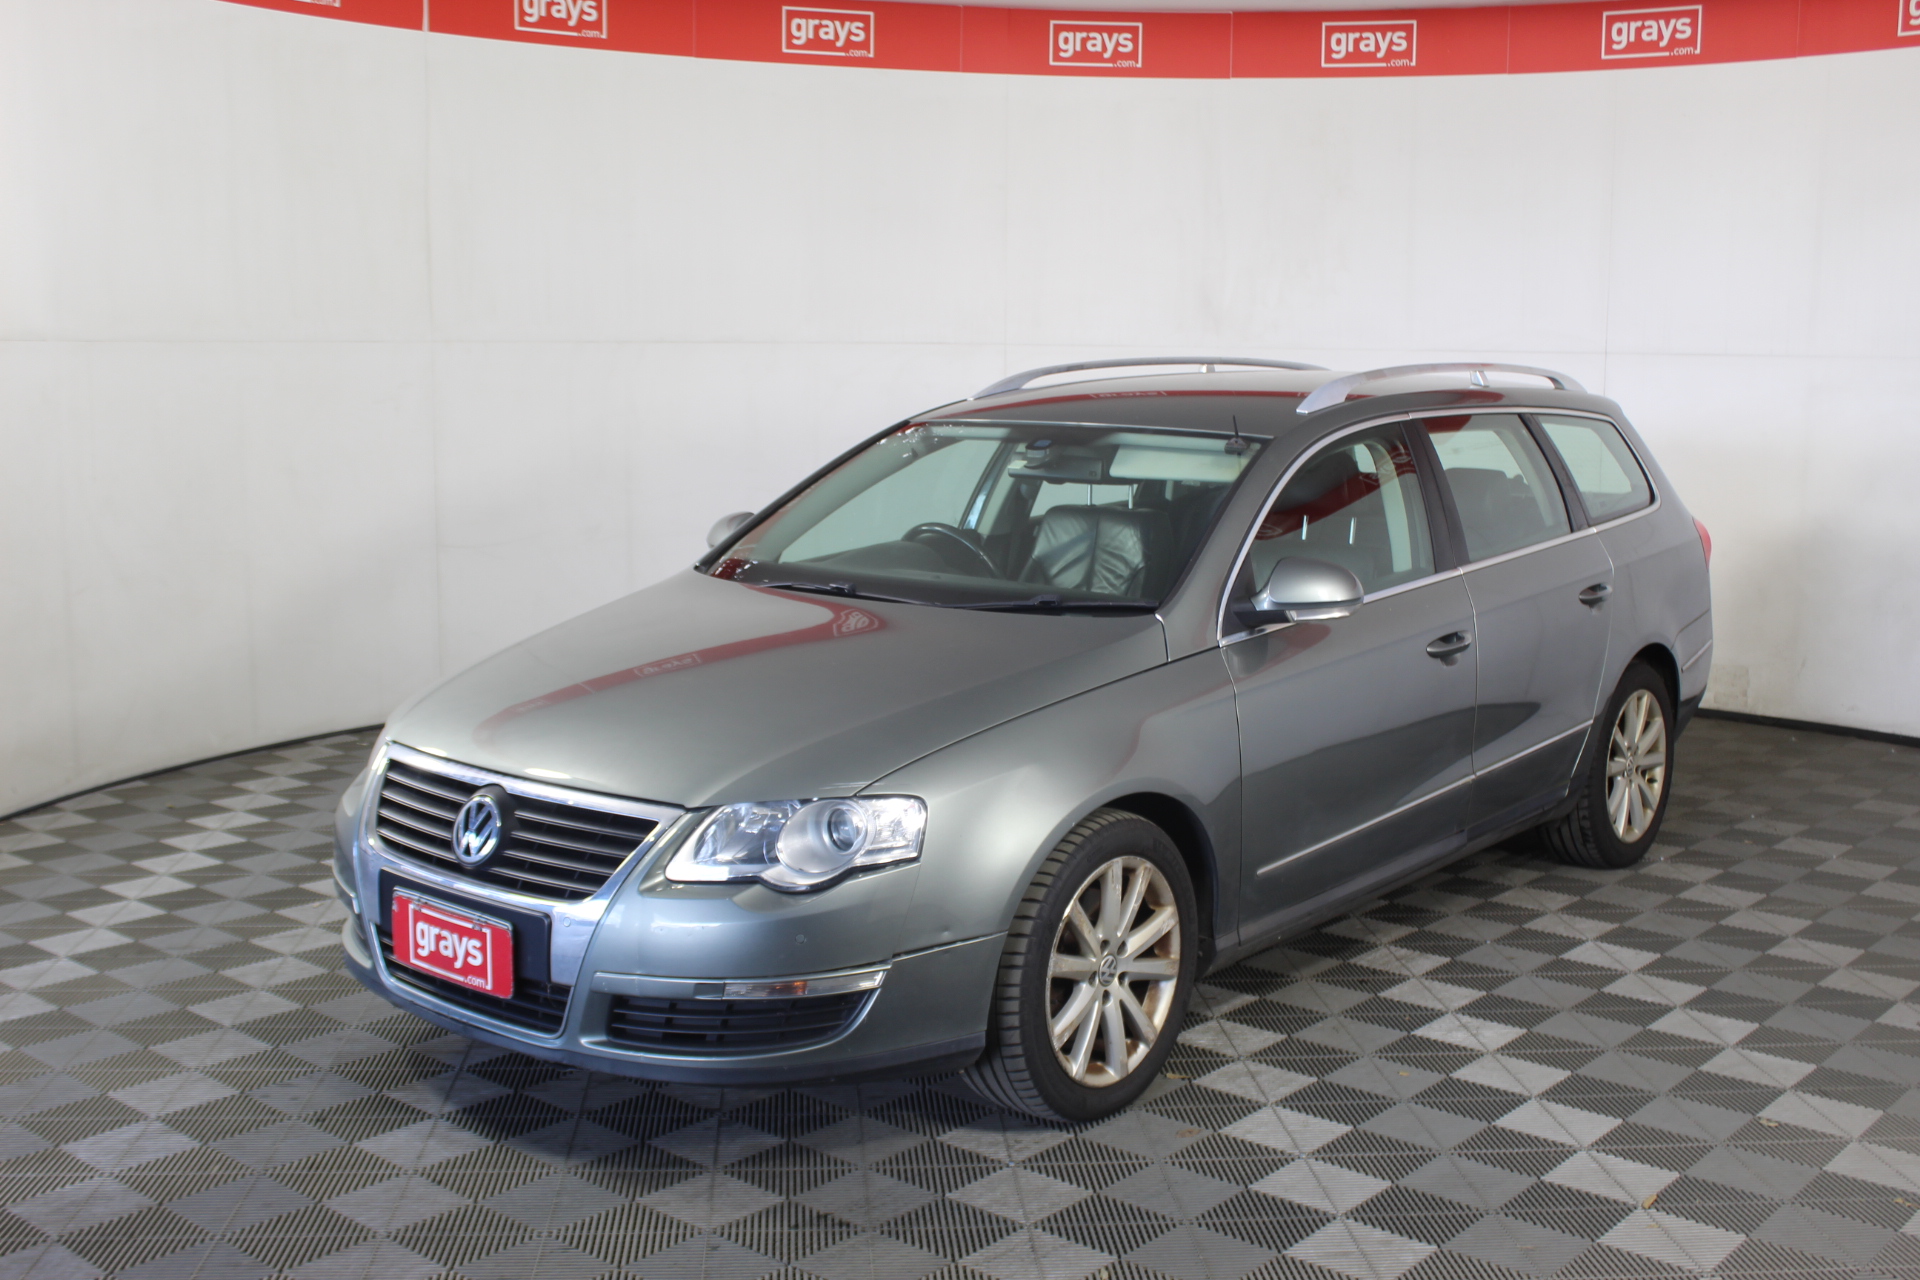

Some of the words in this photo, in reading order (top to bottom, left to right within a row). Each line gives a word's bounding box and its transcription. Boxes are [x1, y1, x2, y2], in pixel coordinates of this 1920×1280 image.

[522, 0, 599, 27] grays
[790, 17, 866, 47] grays
[1058, 31, 1134, 59] grays
[1330, 31, 1408, 60] grays
[1611, 17, 1692, 50] grays
[845, 48, 868, 57] .com
[1113, 59, 1136, 68] .com
[1387, 58, 1410, 67] .com
[1670, 46, 1694, 56] .com
[416, 920, 483, 969] grays
[463, 974, 486, 989] .com
